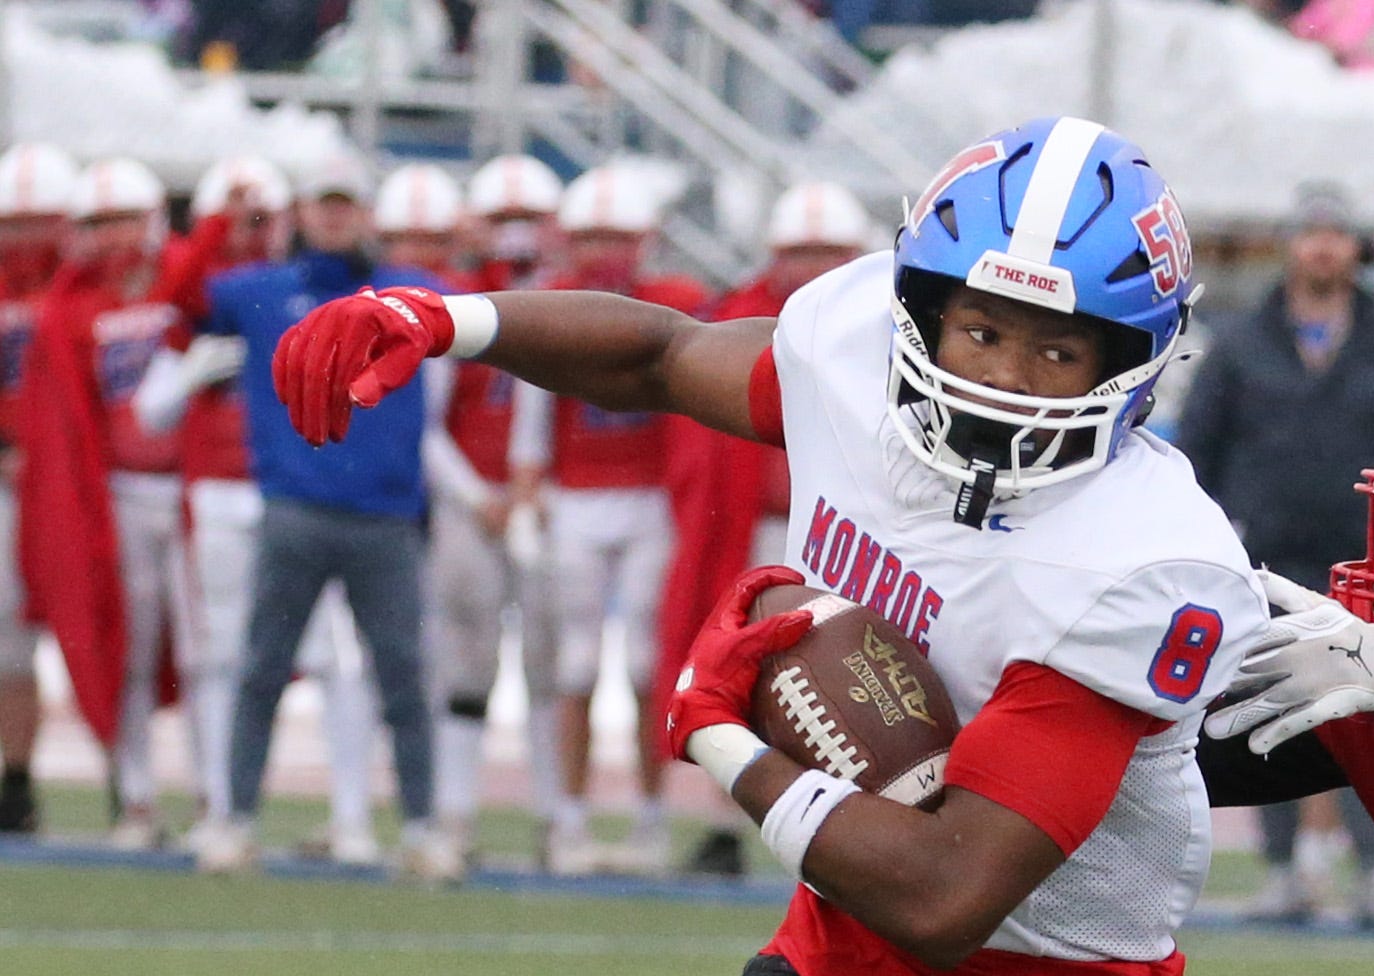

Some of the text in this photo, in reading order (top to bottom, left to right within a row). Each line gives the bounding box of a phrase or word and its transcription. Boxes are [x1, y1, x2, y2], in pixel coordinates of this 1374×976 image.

[994, 264, 1059, 294] THE ROE
[1130, 184, 1193, 298] 58
[801, 495, 944, 658] MONROE
[842, 651, 905, 726] SPALDING
[1147, 601, 1224, 705] 8
